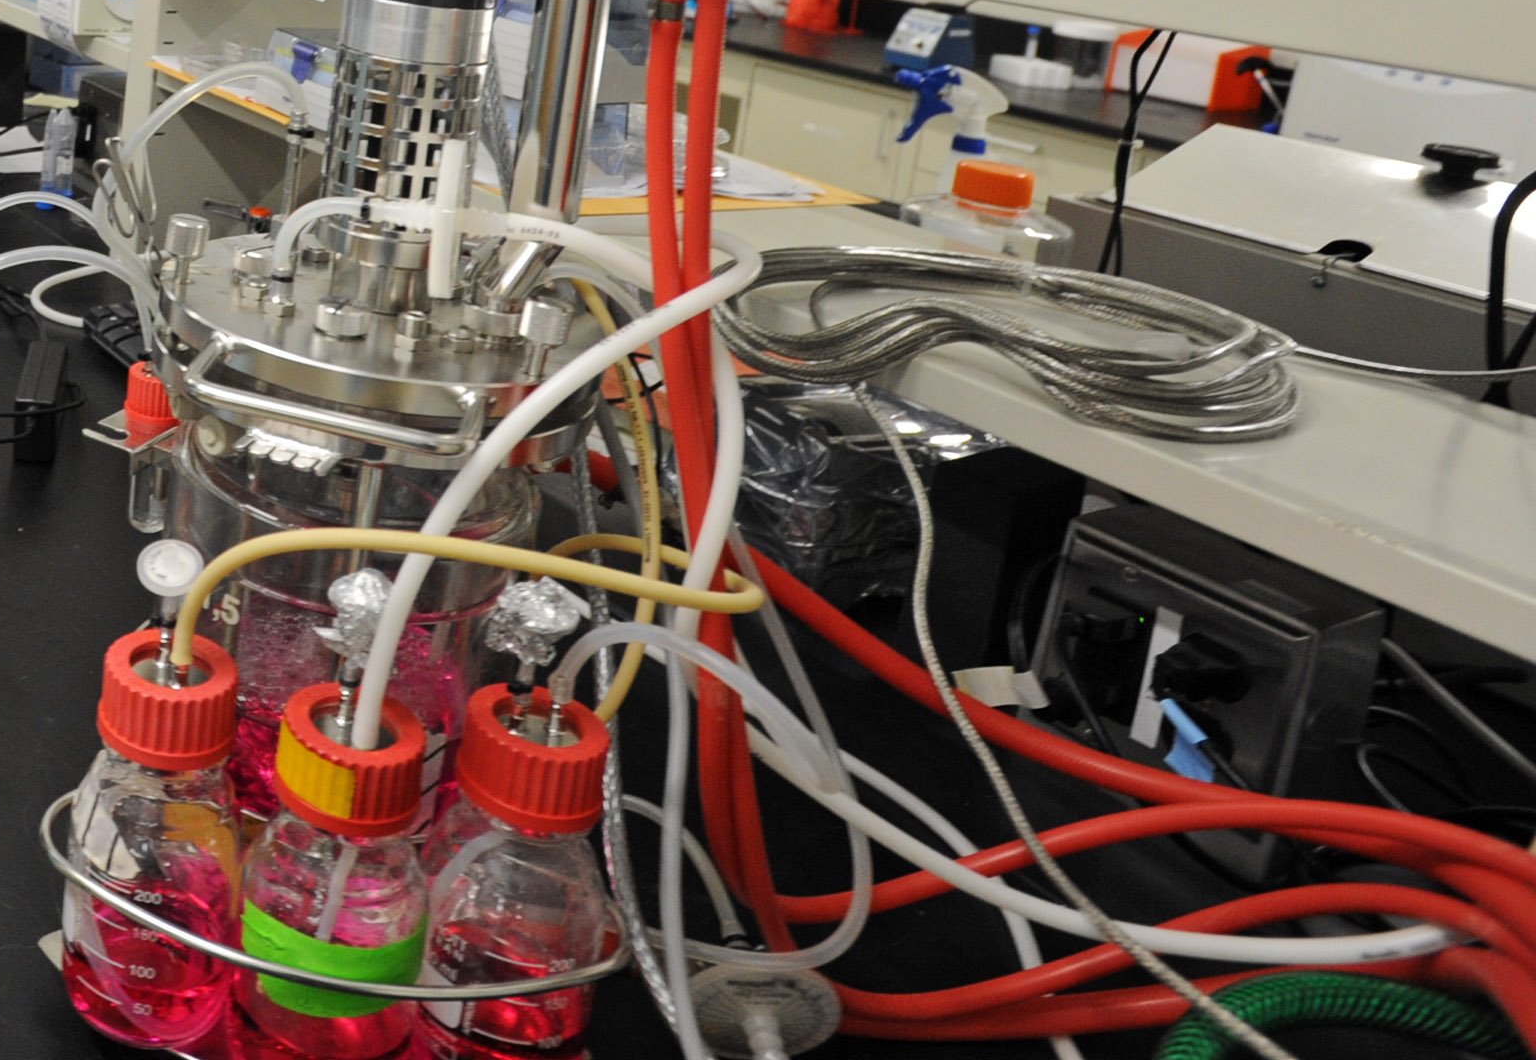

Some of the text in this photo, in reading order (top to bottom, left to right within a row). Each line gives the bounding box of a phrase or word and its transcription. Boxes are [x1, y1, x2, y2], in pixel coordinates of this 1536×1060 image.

[133, 889, 163, 905] 200
[129, 964, 156, 979] 100
[132, 1003, 153, 1016] 50
